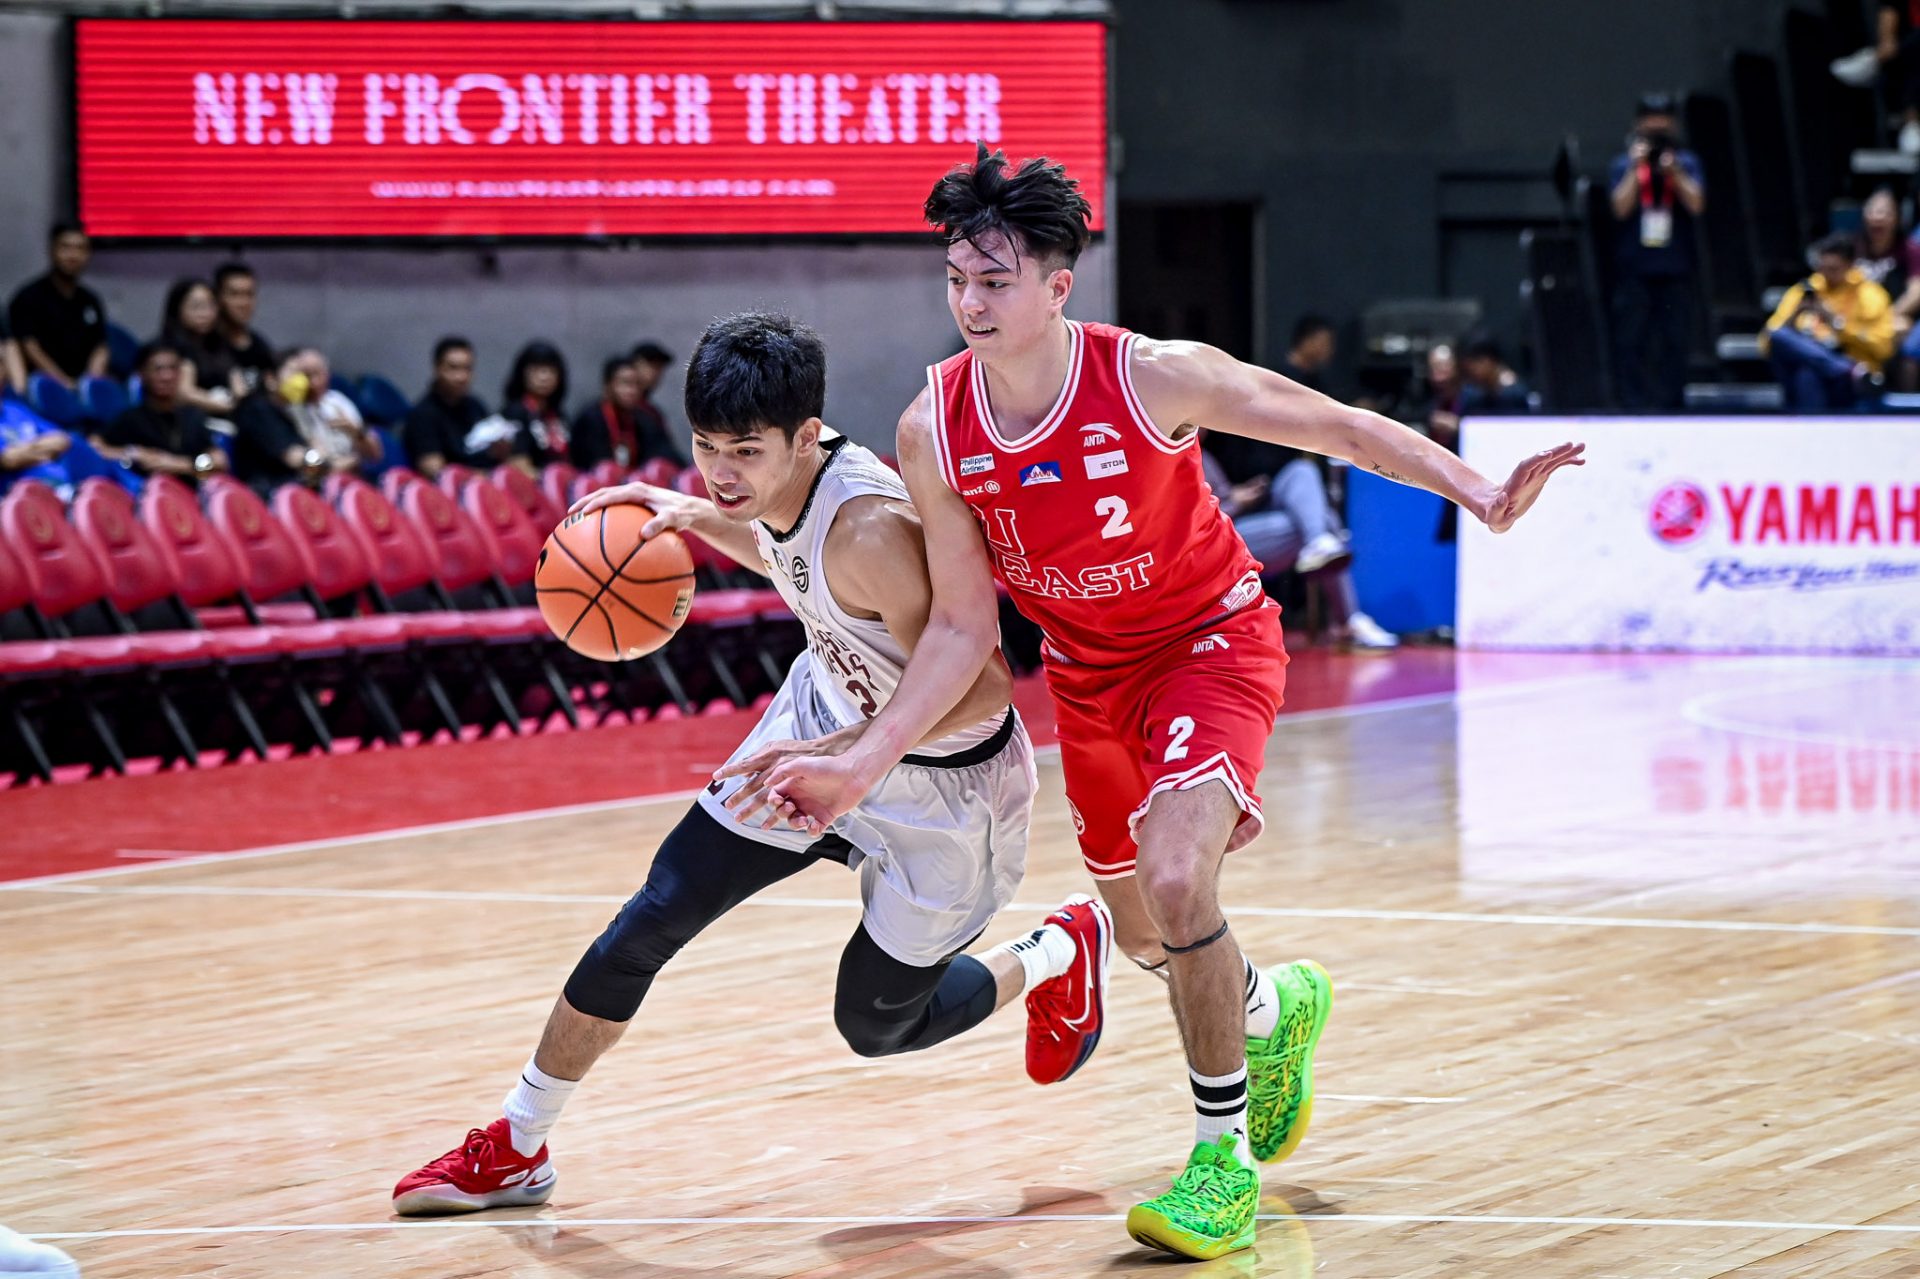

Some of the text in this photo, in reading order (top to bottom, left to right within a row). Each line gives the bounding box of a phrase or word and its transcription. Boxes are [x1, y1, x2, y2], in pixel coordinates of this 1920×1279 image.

[194, 72, 1001, 145] NEW FRONTIER THEATER
[960, 455, 992, 467] Philippine
[1083, 433, 1106, 448] ANTA
[961, 465, 986, 475] Airlines
[1094, 495, 1134, 540] 2
[1721, 484, 1920, 544] YAMAH
[989, 541, 1154, 599] EAST
[1192, 639, 1215, 654] ANTA
[1163, 715, 1196, 764] 2
